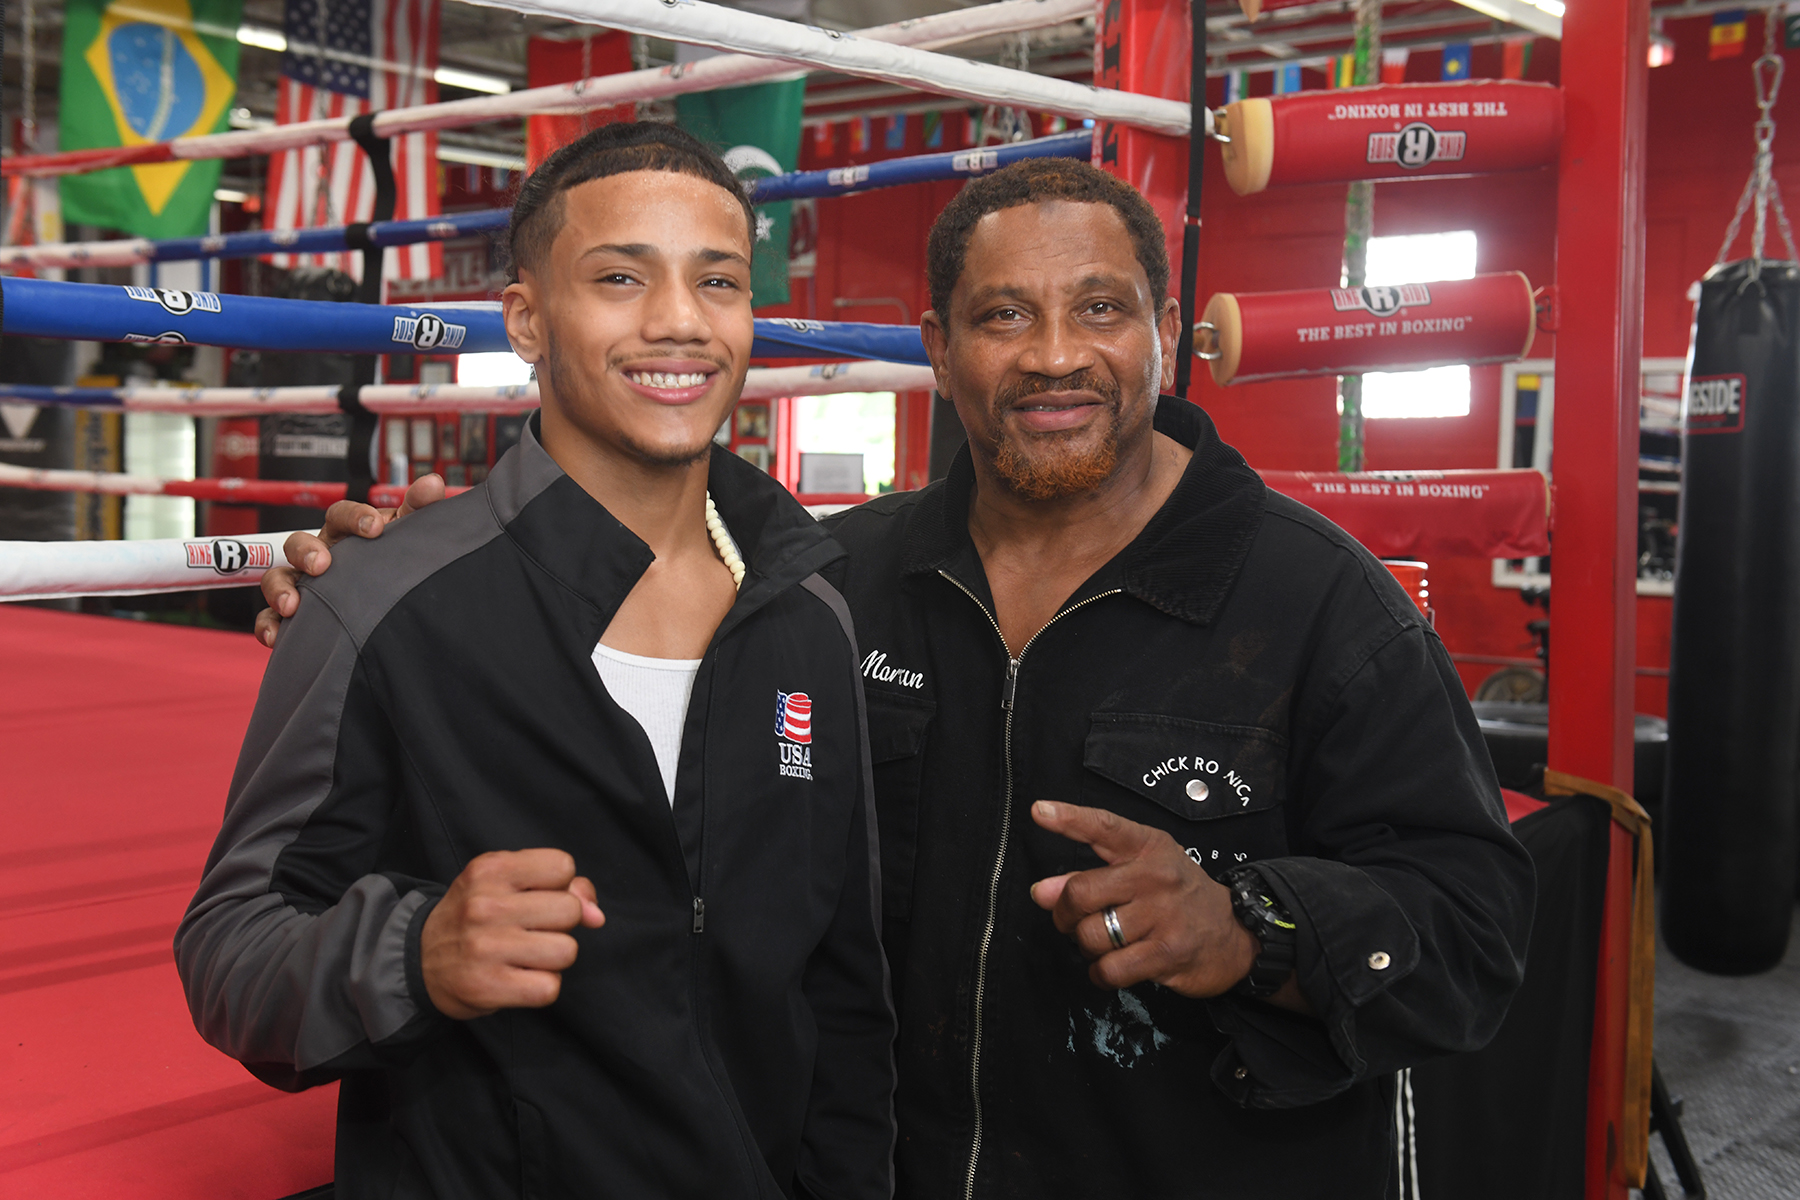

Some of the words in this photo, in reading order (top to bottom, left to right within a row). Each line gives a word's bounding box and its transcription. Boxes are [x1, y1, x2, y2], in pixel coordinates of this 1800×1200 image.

[1404, 103, 1423, 118] IN
[1427, 102, 1469, 118] BEST
[1473, 101, 1508, 117] THE
[1370, 136, 1397, 160] SIDE
[393, 319, 416, 341] SIDE
[417, 317, 441, 348] R
[442, 326, 465, 348] RING
[1297, 326, 1331, 343] THE
[1334, 322, 1376, 340] BEST
[1379, 321, 1398, 336] IN
[1312, 482, 1347, 494] THE
[1350, 483, 1392, 496] BEST
[1396, 483, 1415, 497] IN
[187, 544, 212, 566] RING
[216, 540, 242, 570] R
[248, 544, 271, 567] SIDE
[778, 742, 813, 768] USA
[779, 763, 812, 780] BOXING
[1142, 756, 1190, 787] CHICK
